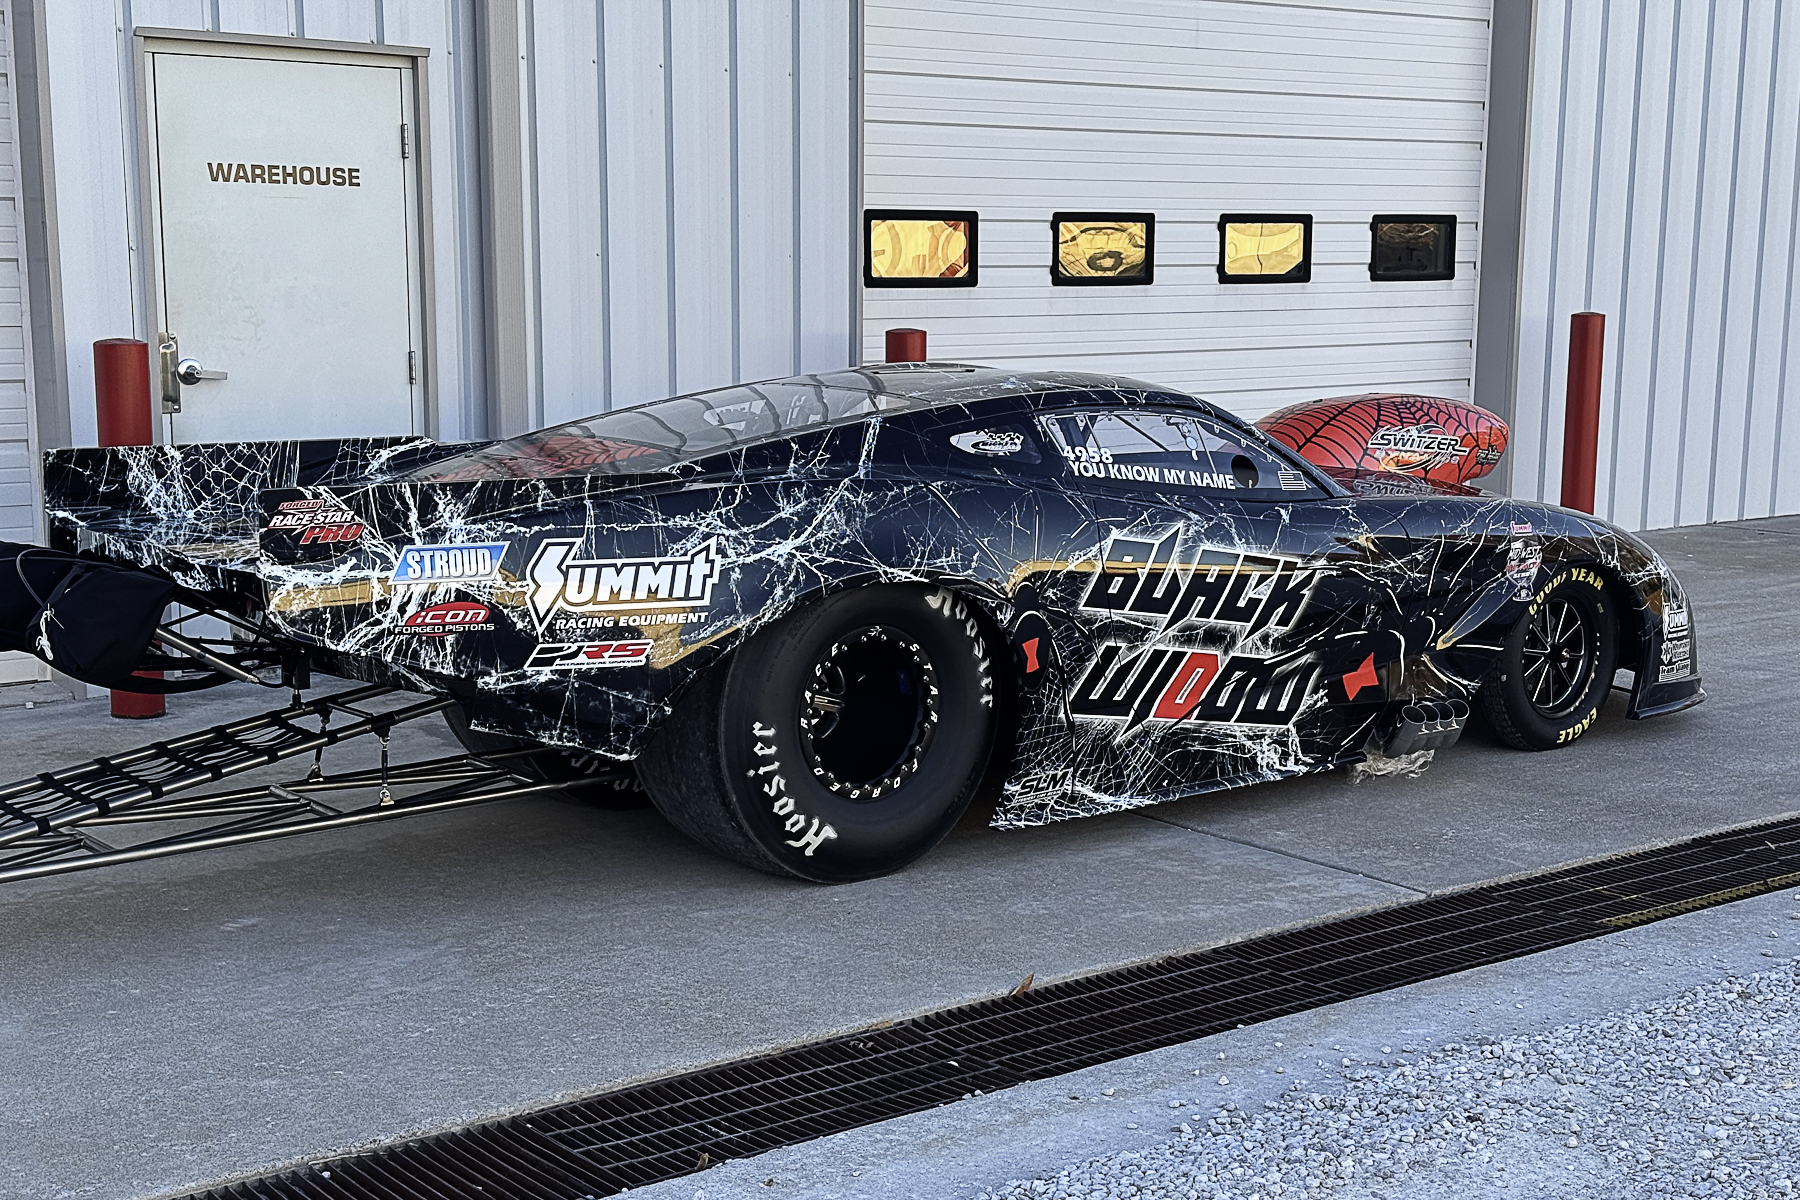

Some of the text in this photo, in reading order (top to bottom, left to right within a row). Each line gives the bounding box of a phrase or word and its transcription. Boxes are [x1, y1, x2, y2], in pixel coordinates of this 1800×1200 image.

[207, 162, 361, 187] WAREHOUSE
[1062, 446, 1113, 464] 4958
[1367, 432, 1469, 455] SWITZER
[1068, 461, 1236, 490] YOU KNOW MY NAME
[278, 501, 322, 510] FORGED
[268, 510, 355, 527] RACE STAR
[299, 522, 365, 545] PRO
[406, 548, 493, 579] STROUD
[1079, 521, 1323, 648] BLACK
[1571, 568, 1604, 590] YEAR
[395, 623, 495, 634] FORGED PISTONS
[555, 612, 708, 630] RACING EQUIPMENT
[1062, 642, 1323, 744] WIDOW
[1557, 707, 1597, 743] EAGLE
[746, 721, 838, 856] Hoosier
[1016, 767, 1072, 798] SLM
